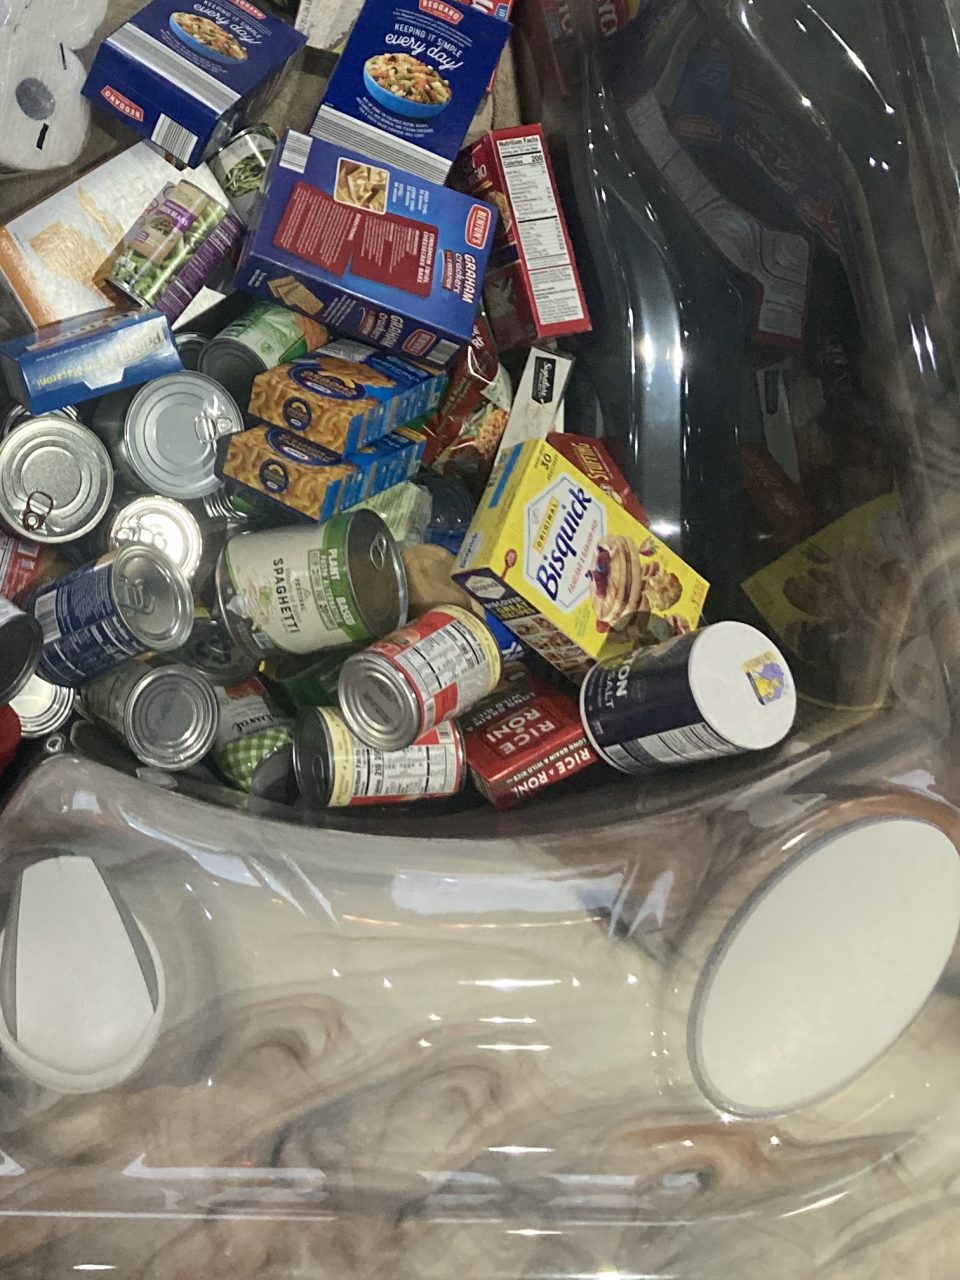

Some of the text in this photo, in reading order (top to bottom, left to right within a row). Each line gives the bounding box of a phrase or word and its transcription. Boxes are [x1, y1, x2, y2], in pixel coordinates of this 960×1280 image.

[193, 3, 231, 31] every
[203, 0, 262, 38] KEEPING SIMPLE
[422, 0, 461, 22] REGGANO
[385, 33, 464, 70] every day!
[395, 23, 426, 39] KEEPING
[437, 37, 463, 58] SIMPLE
[499, 136, 539, 148] Nutrition Facts
[531, 154, 544, 163] 200
[475, 210, 488, 245] BENTON'S
[453, 253, 464, 294] crackers
[461, 253, 477, 304] GRAHAM
[382, 314, 404, 348] GRAHAM
[541, 361, 553, 397] Signature
[541, 453, 552, 471] 30
[571, 442, 609, 482] STUFFING
[536, 503, 558, 548] ORIGINAL
[536, 484, 593, 603] Bisquick
[273, 558, 300, 633] SPAGHETTI
[328, 548, 356, 625] PLANT BASED
[486, 708, 541, 742] RONI
[500, 720, 556, 755] RICE
[512, 737, 587, 782] LONG GRAIN WILD RICE
[513, 747, 591, 797] RICE RONI
[353, 769, 364, 797] Nutrition
